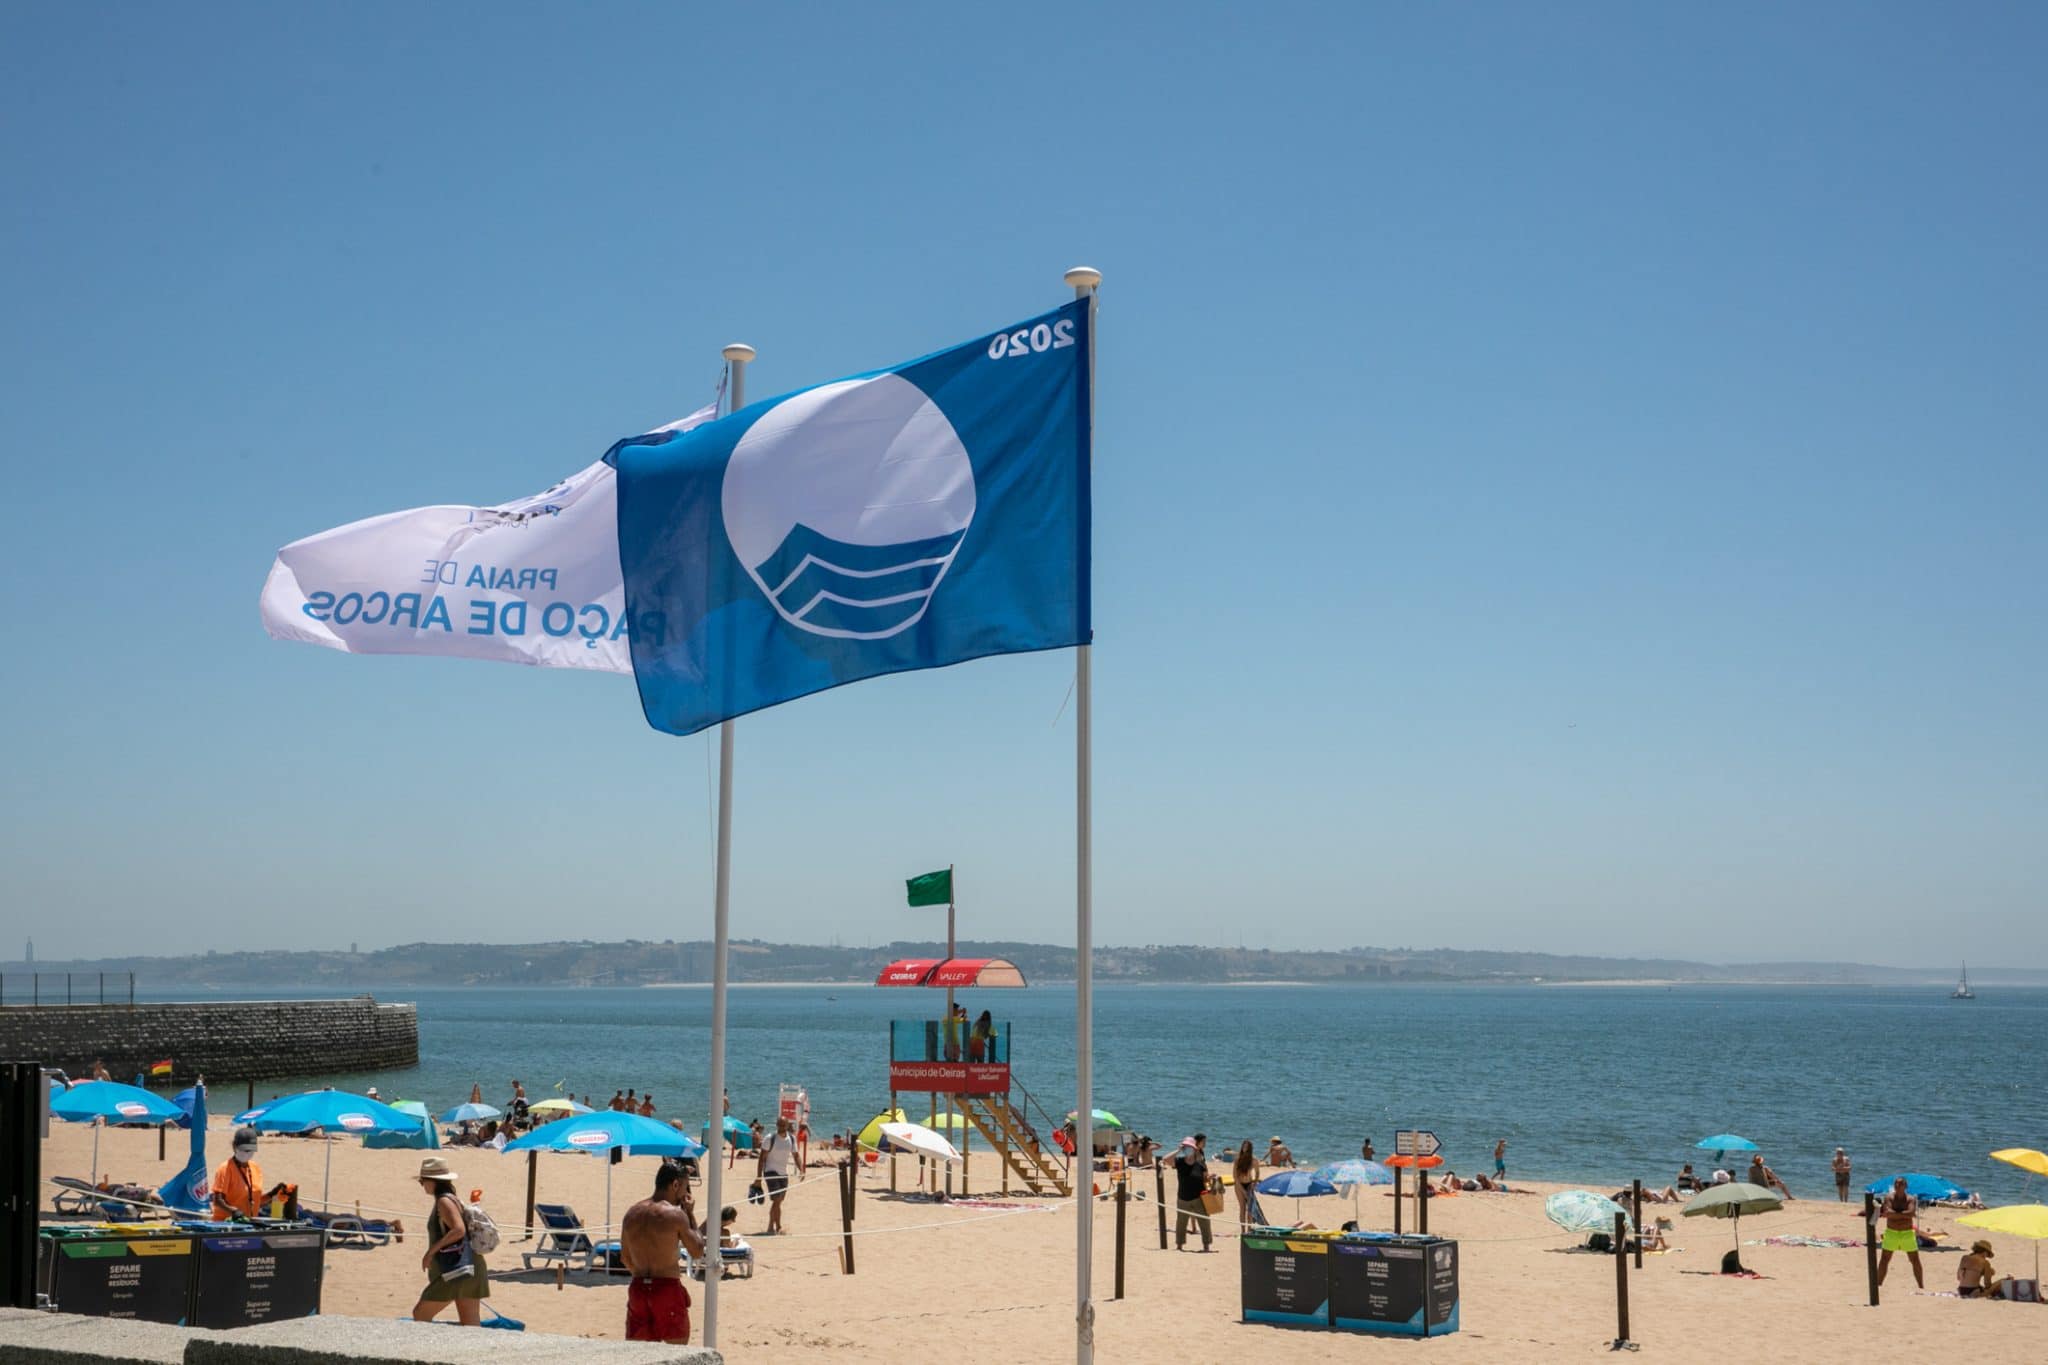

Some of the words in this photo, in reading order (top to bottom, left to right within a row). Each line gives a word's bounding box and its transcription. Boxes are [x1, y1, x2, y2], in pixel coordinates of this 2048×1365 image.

[927, 1067, 938, 1078] de
[939, 1067, 966, 1078] Oeiras
[247, 1257, 275, 1265] SEPARE
[109, 1264, 141, 1273] SEPARE
